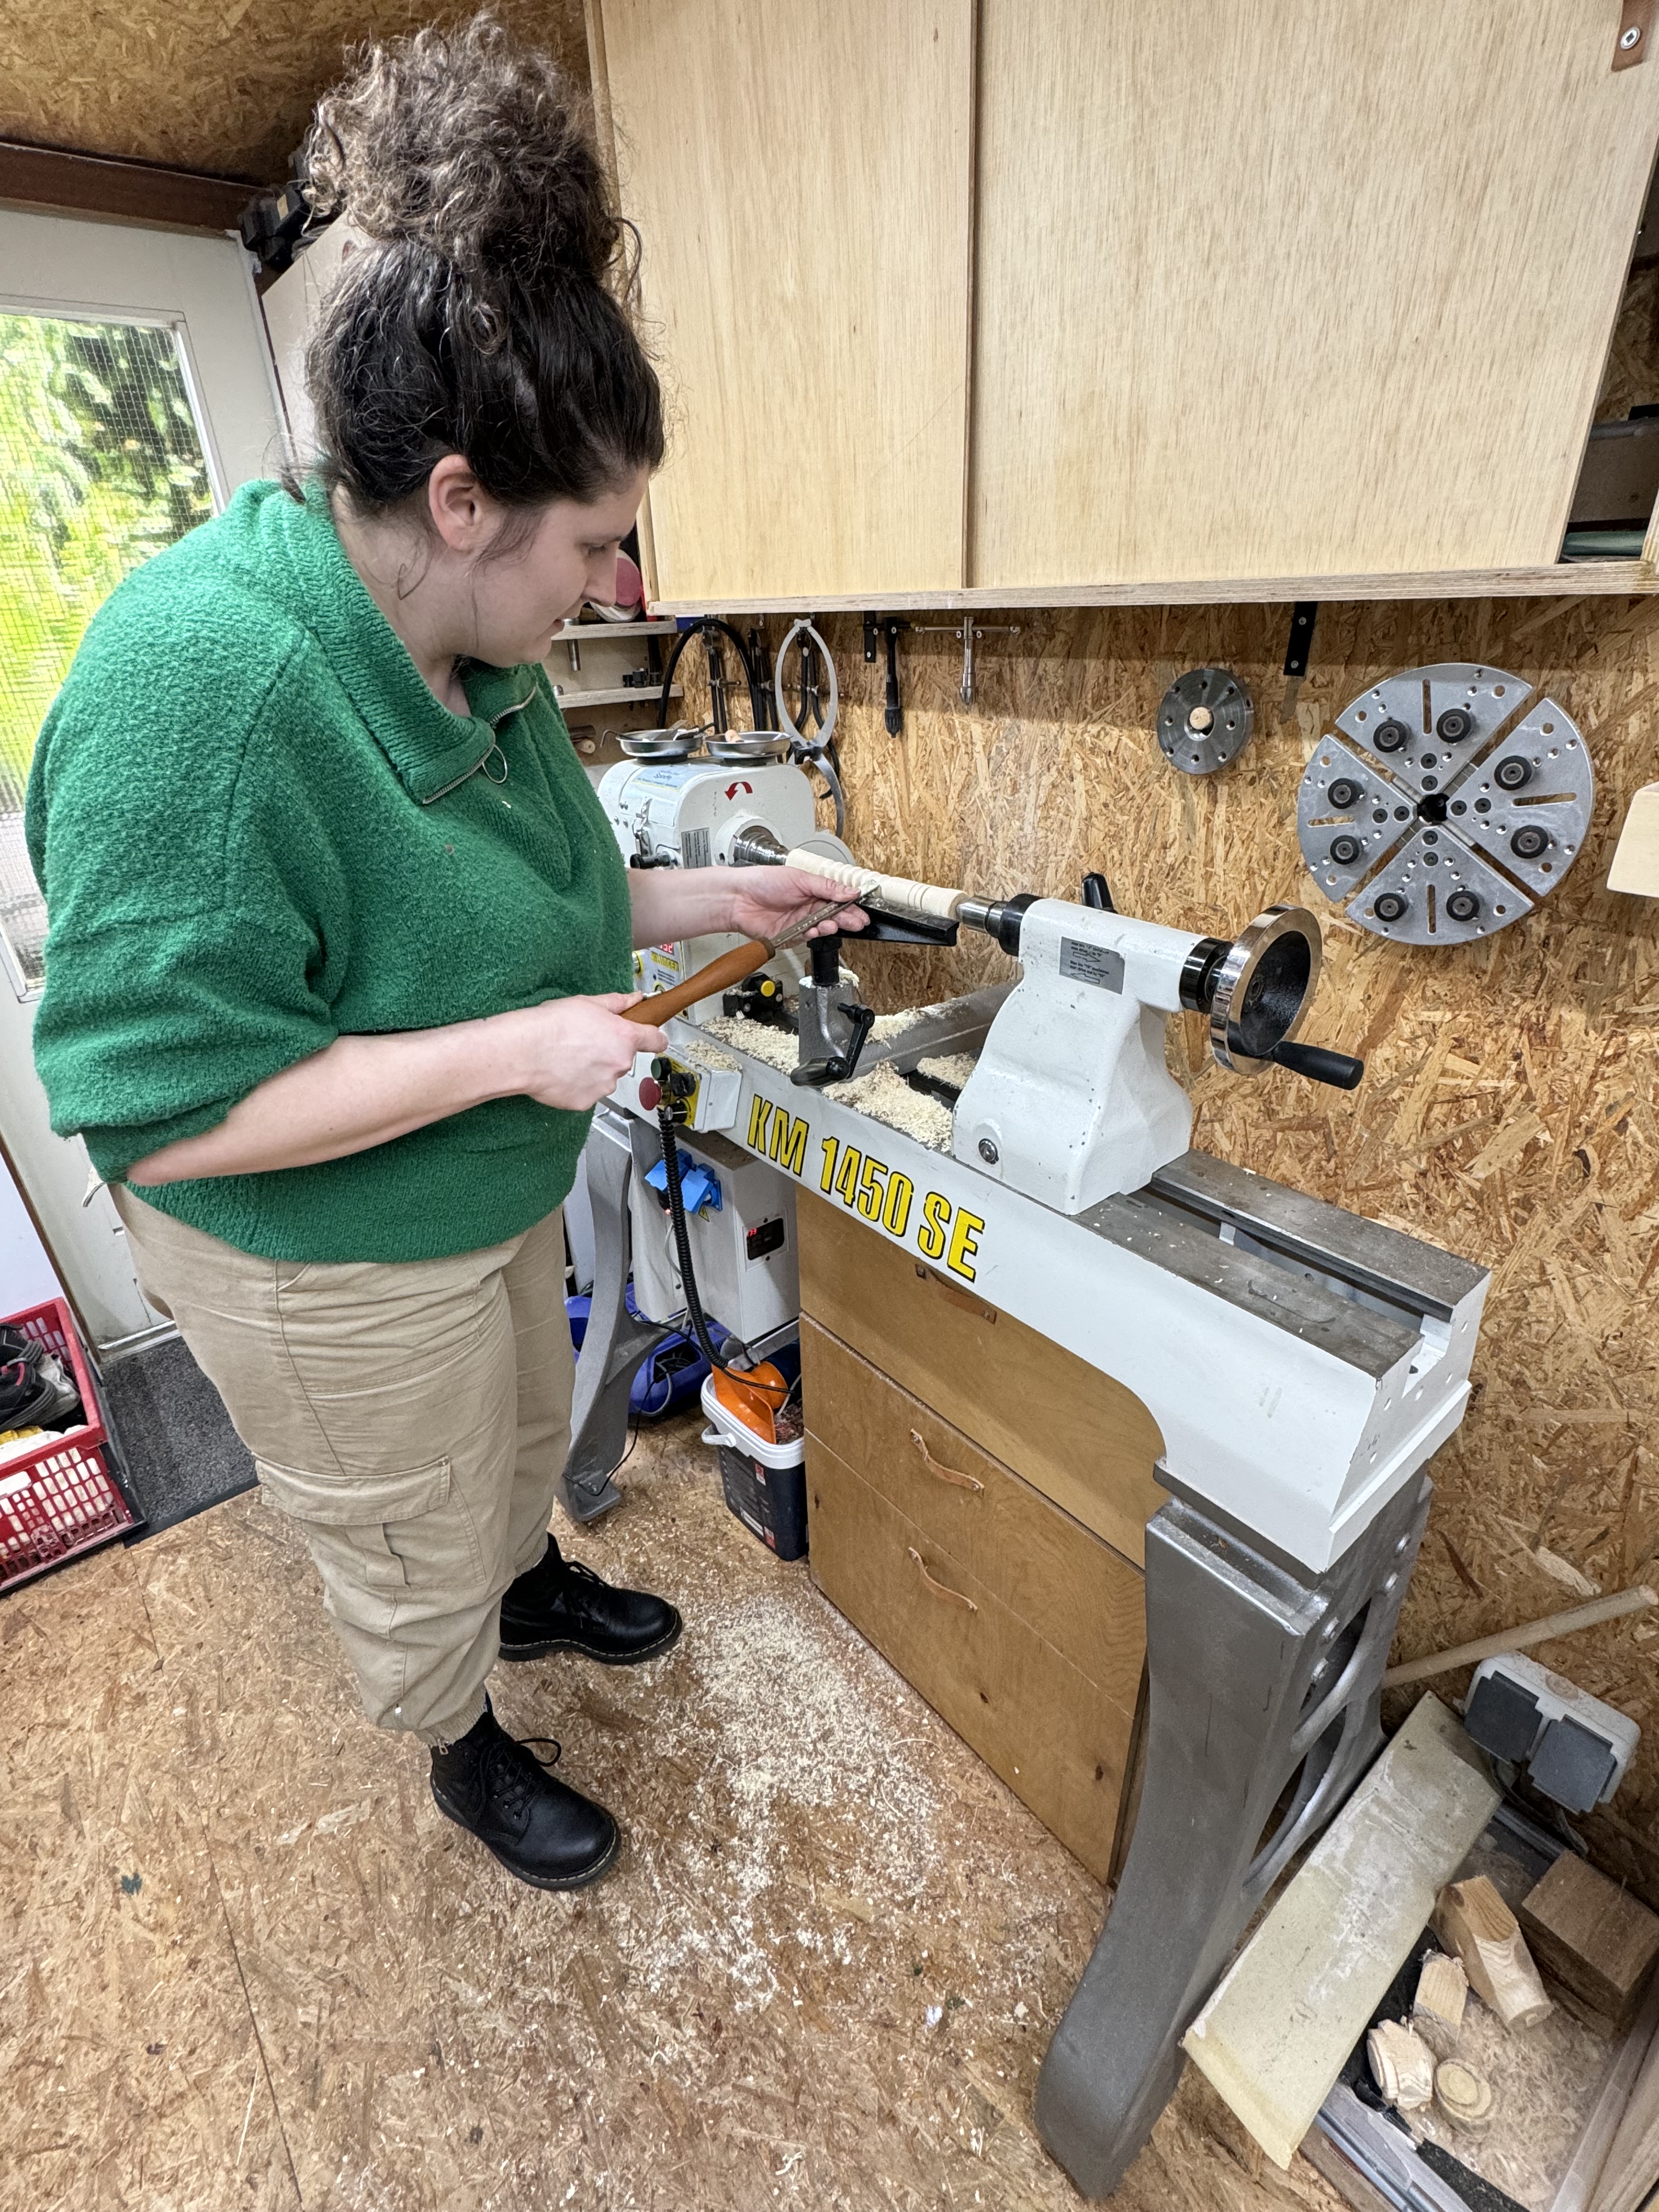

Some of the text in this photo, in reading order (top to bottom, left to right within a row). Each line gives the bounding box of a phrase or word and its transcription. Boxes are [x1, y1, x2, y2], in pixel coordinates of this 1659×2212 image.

[747, 1093, 985, 1283] KM 1450 SE
